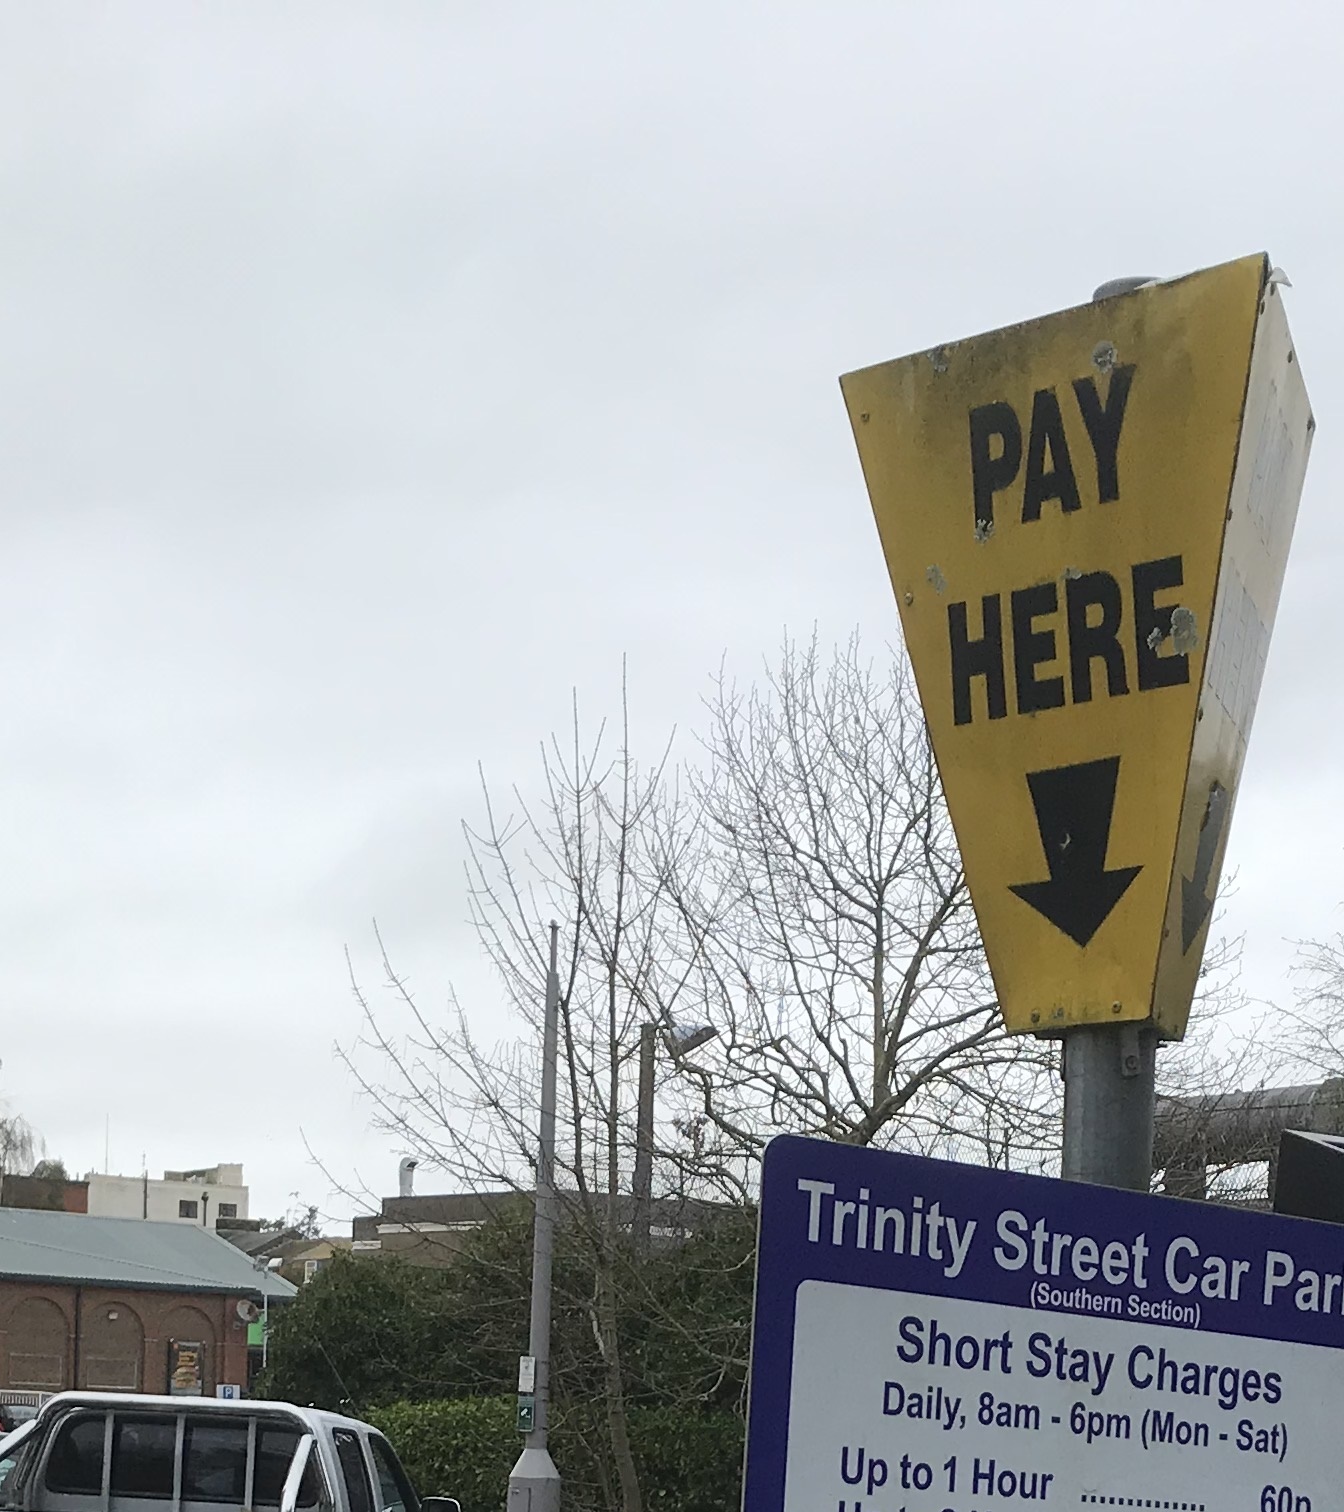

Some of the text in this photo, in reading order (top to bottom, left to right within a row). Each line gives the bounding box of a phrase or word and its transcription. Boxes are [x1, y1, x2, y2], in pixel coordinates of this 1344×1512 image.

[967, 364, 1137, 532] PAY
[947, 555, 1190, 725] HERE
[793, 1177, 978, 1281] Trinity
[992, 1208, 1150, 1289] Street
[1163, 1234, 1251, 1303] Car
[1029, 1282, 1201, 1329] (Southern Section)
[895, 1315, 1284, 1416] Short Stay Charges
[881, 1381, 968, 1432] Daily,
[976, 1391, 1041, 1431] 8am
[1068, 1401, 1132, 1448] 6pm
[1139, 1409, 1210, 1455] (Mon
[1234, 1419, 1289, 1463] Sat)
[839, 1445, 890, 1497] Up
[898, 1450, 934, 1491] to
[941, 1454, 957, 1493] 1
[971, 1457, 1054, 1501] Hour
